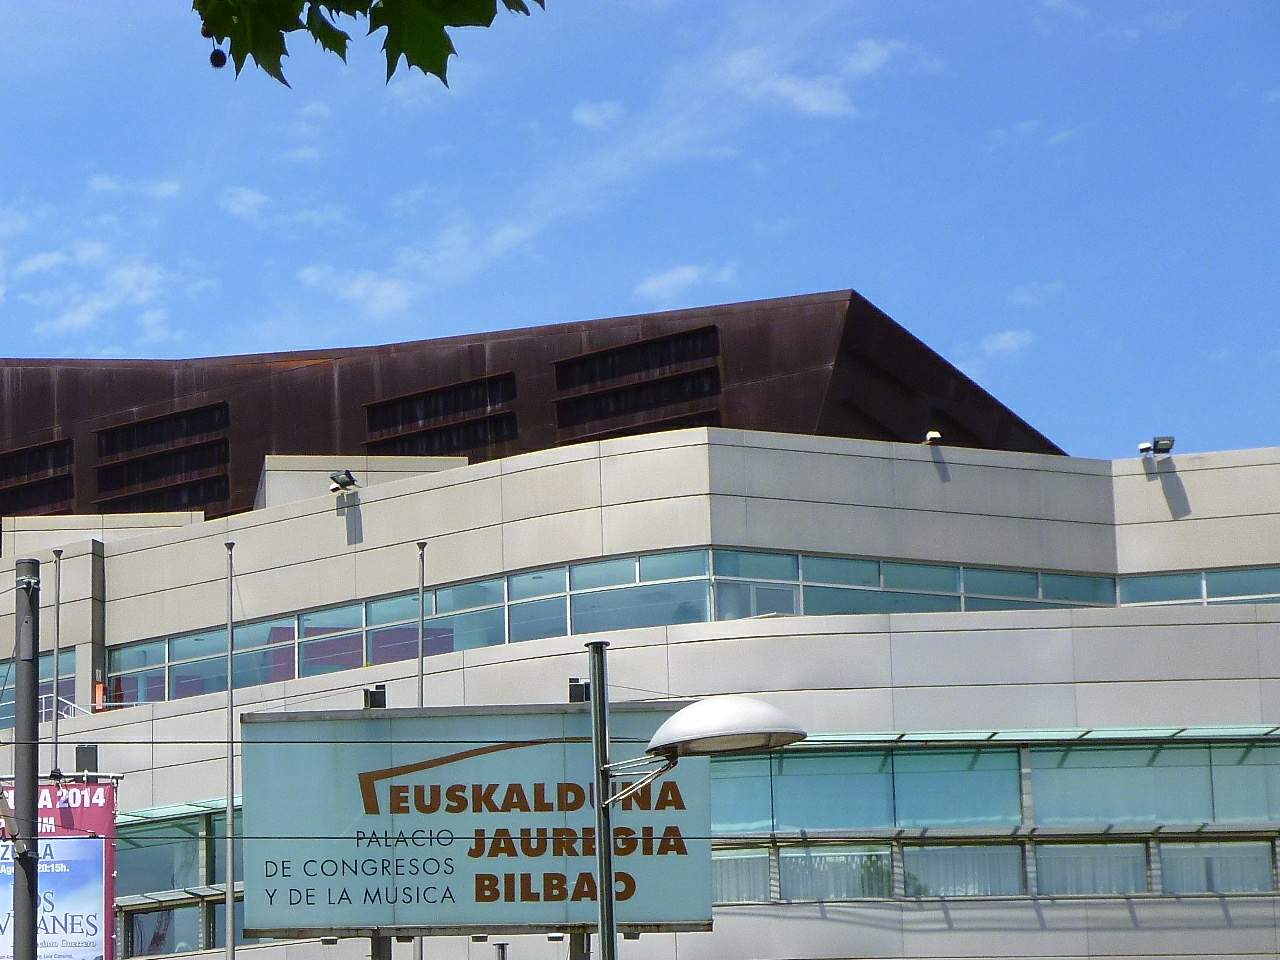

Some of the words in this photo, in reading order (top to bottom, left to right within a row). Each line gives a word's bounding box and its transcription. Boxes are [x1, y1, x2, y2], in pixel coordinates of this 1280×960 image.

[55, 788, 106, 809] 2014
[356, 829, 455, 848] PALACIO
[467, 826, 688, 859] JAUREGIA
[265, 860, 292, 877] DE
[303, 857, 455, 877] CONGRESOS
[265, 888, 277, 905] Y
[289, 887, 316, 905] DE
[328, 886, 353, 905] LA
[363, 885, 456, 905] MUSICA
[474, 871, 637, 903] BILBAO
